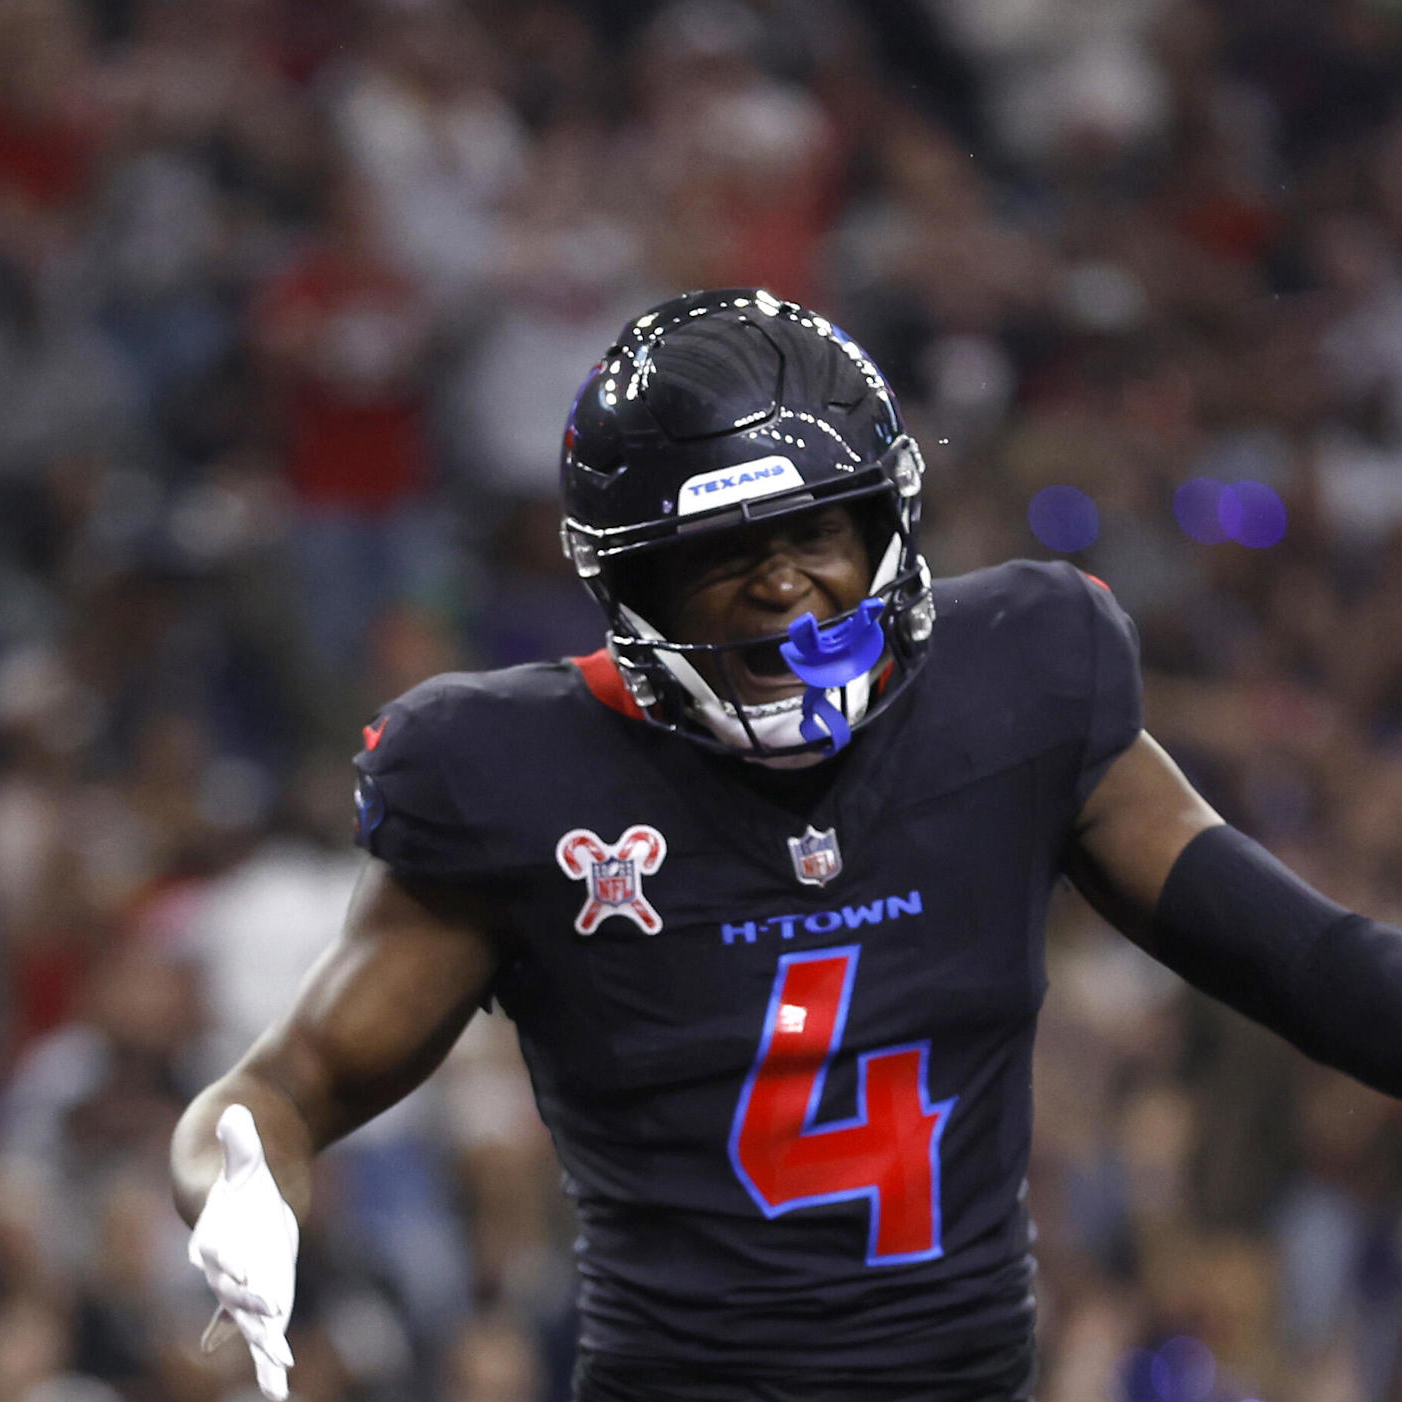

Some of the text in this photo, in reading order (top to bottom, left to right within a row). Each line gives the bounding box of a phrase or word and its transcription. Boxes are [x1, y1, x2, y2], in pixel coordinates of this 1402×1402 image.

[687, 464, 785, 497] TEXANS
[720, 889, 924, 945] H-TOWN
[727, 943, 961, 1267] 4
